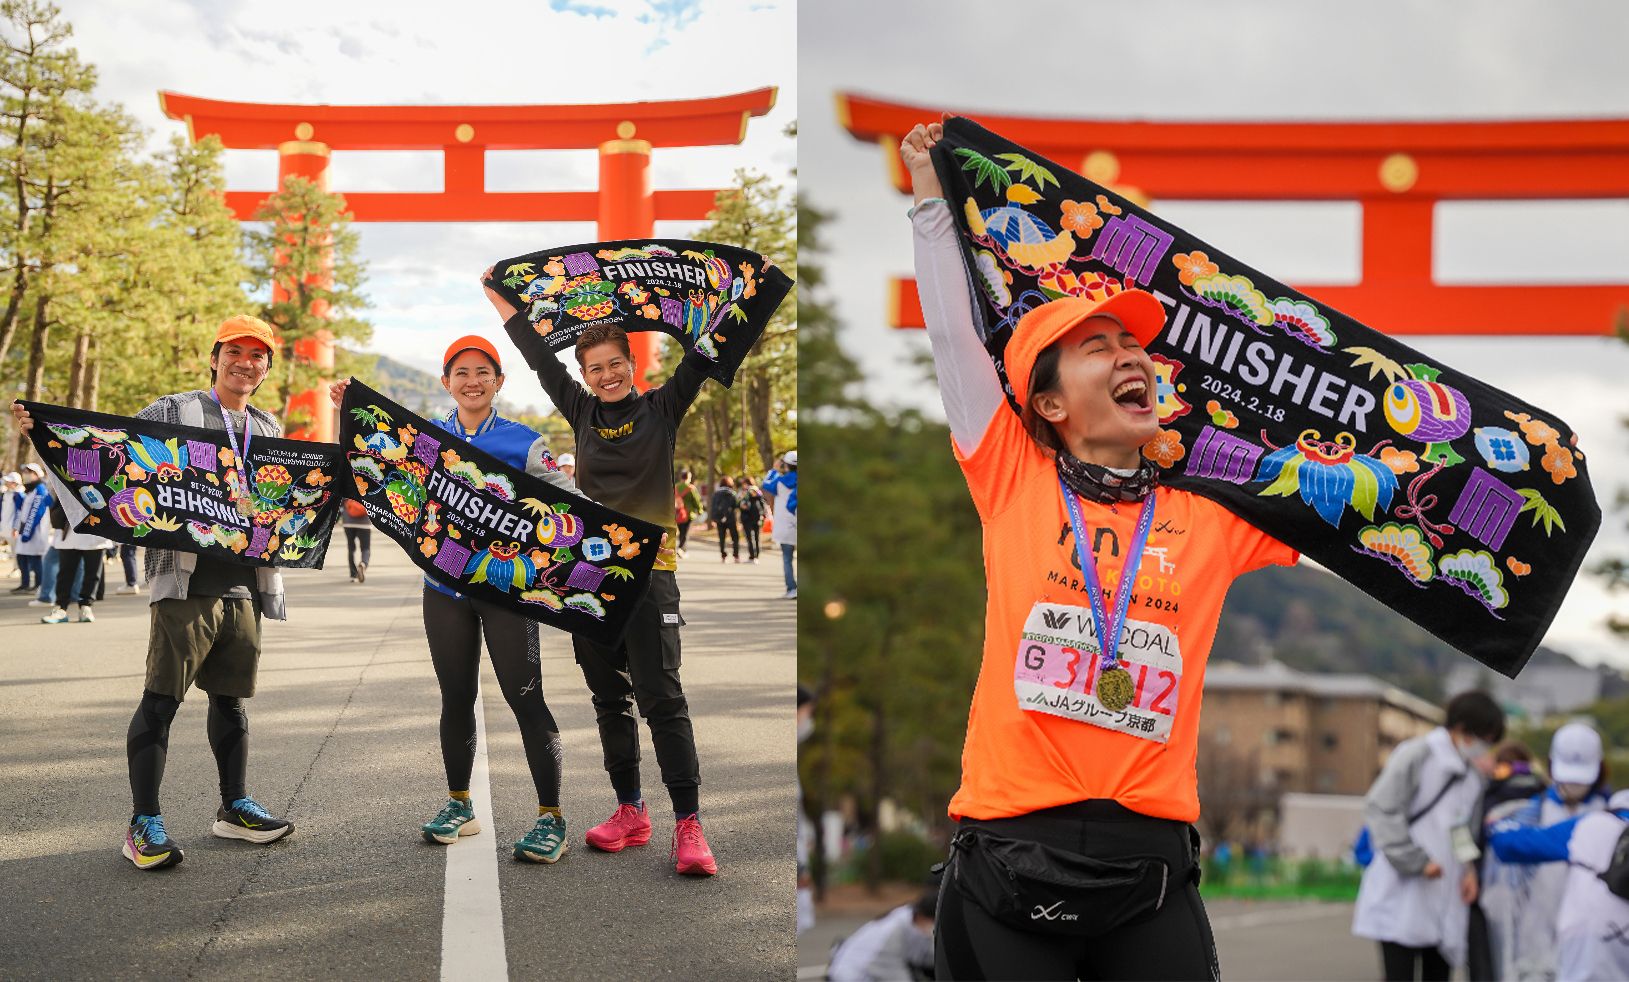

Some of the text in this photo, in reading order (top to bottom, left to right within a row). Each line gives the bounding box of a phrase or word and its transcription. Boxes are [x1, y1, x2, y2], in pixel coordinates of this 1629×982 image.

[603, 262, 706, 288] FINISHER
[646, 279, 682, 288] 2024.2.18
[564, 319, 602, 334] MARATHON
[1201, 375, 1285, 423] 2024.2.18
[190, 481, 222, 498] 2024.2.18
[428, 470, 534, 542] FINISHER
[446, 511, 486, 537] 2024.2.18
[1047, 570, 1179, 613] MARAHN 2024
[1106, 568, 1181, 596] KOTO
[1077, 614, 1175, 657] WCOAL
[1025, 644, 1046, 670] G
[1053, 647, 1177, 715] 3112
